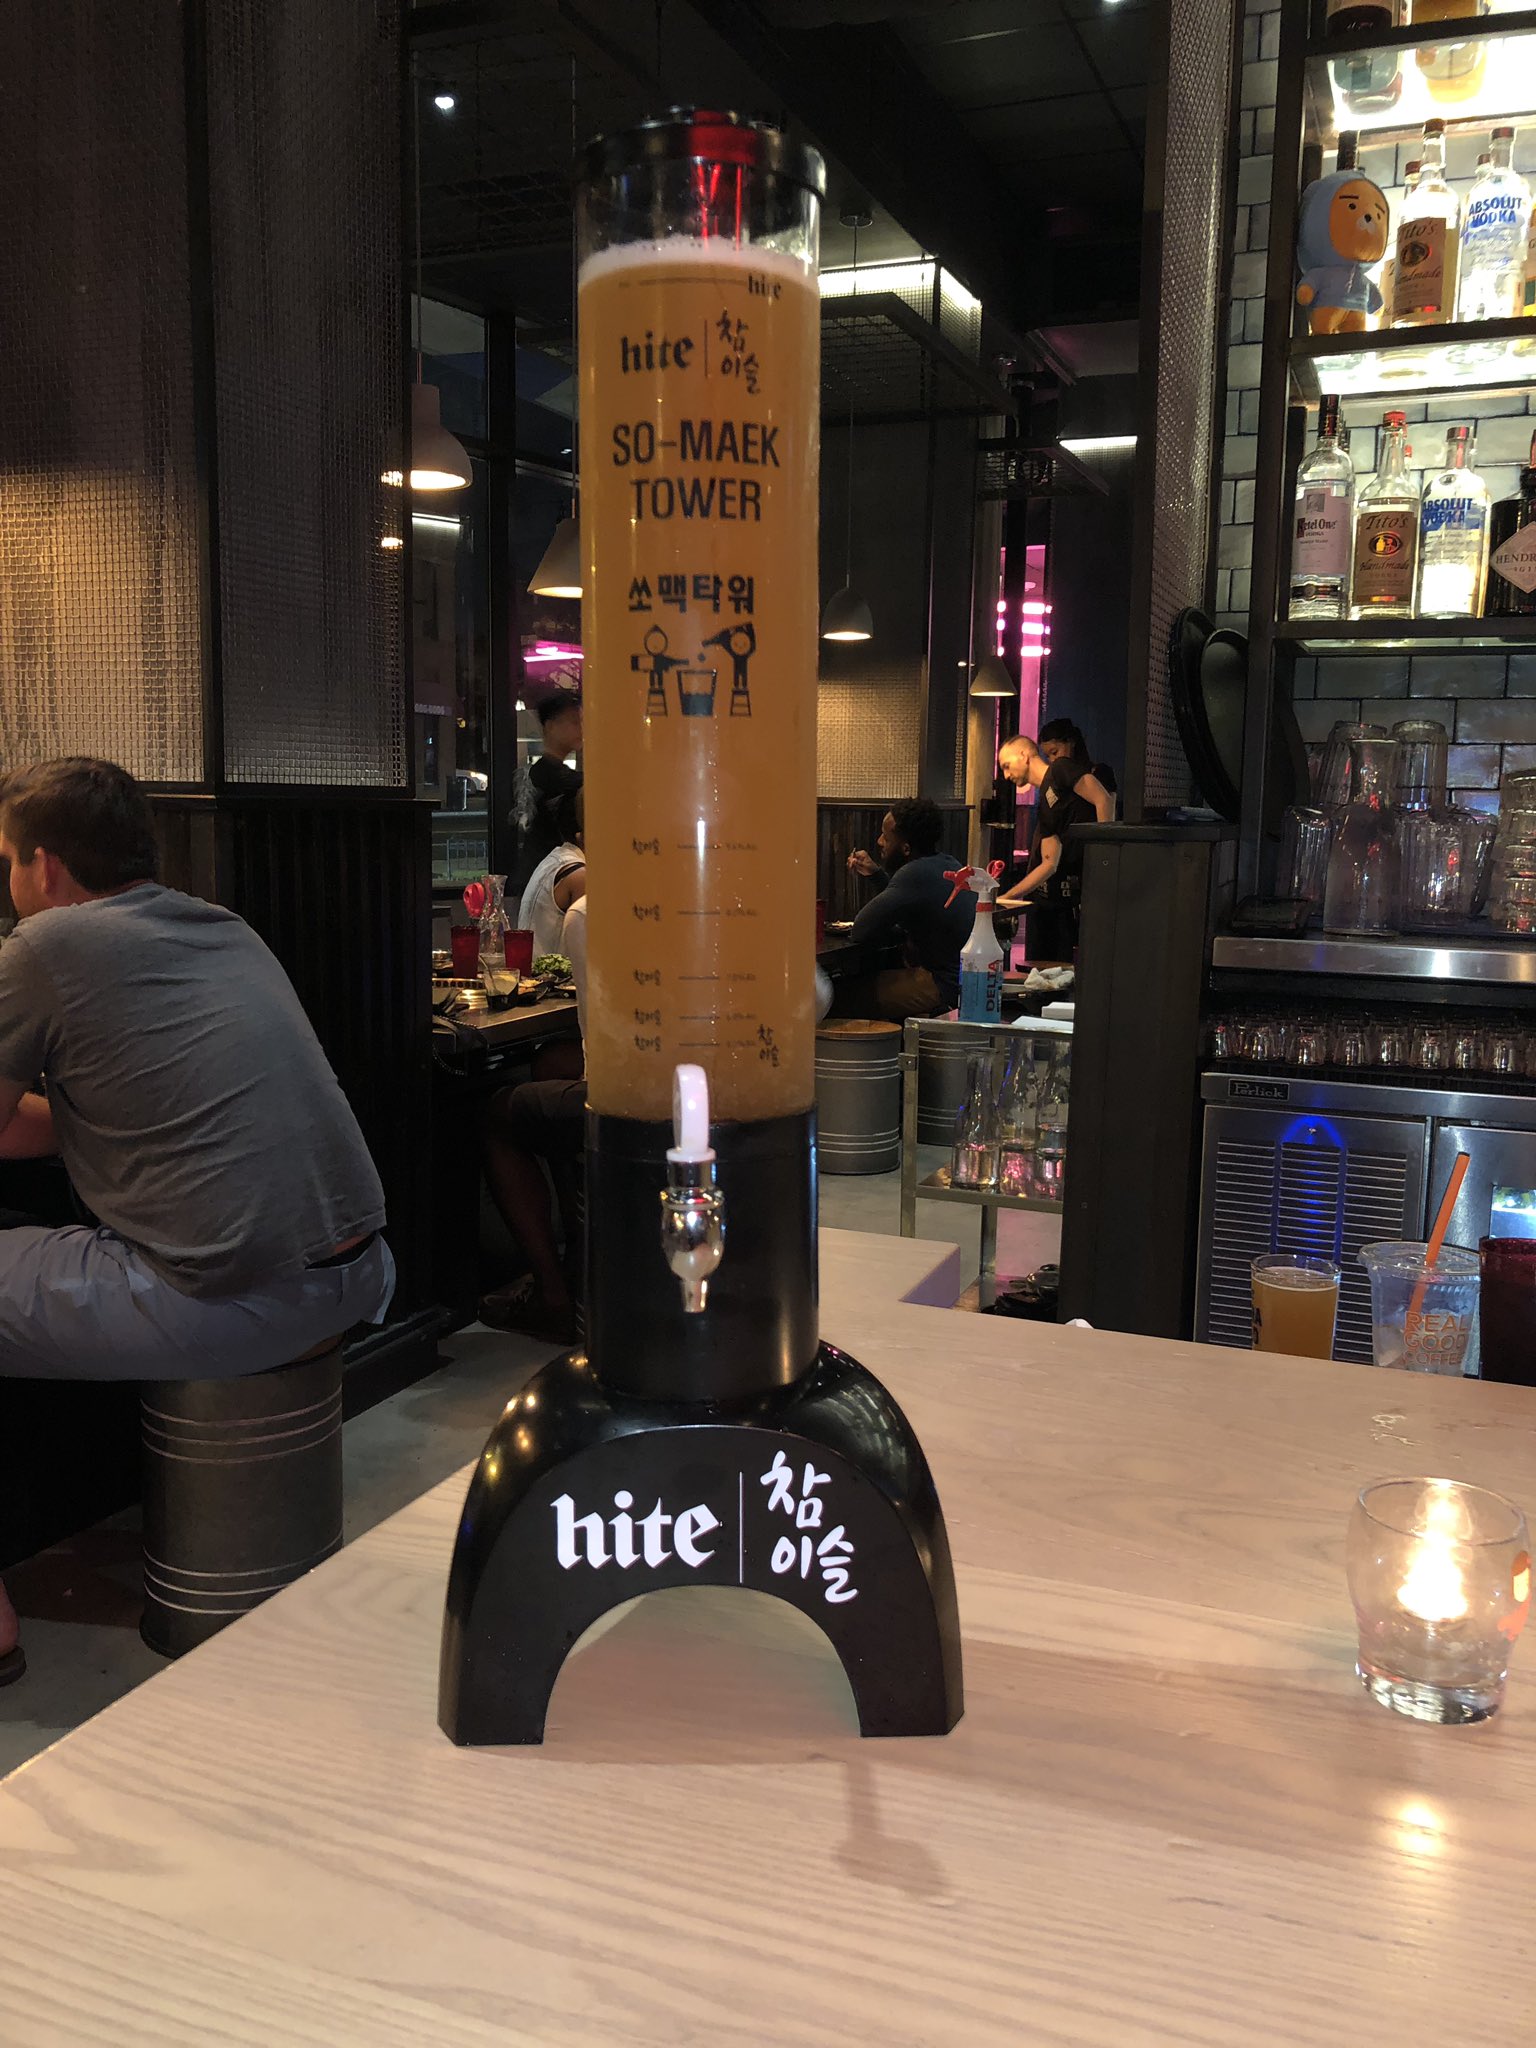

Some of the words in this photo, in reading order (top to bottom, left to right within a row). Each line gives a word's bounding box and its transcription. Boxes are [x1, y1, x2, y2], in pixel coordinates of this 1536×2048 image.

[1469, 196, 1522, 216] ABSOLUT
[613, 420, 780, 467] SO-MAEK
[629, 476, 761, 522] TOWER
[1423, 498, 1473, 511] ABSOLUT
[1366, 514, 1409, 530] Tito's
[986, 959, 999, 1011] DELTA
[1405, 1311, 1471, 1332] REAL
[1404, 1332, 1467, 1351] GOOD
[550, 1490, 719, 1569] hite
